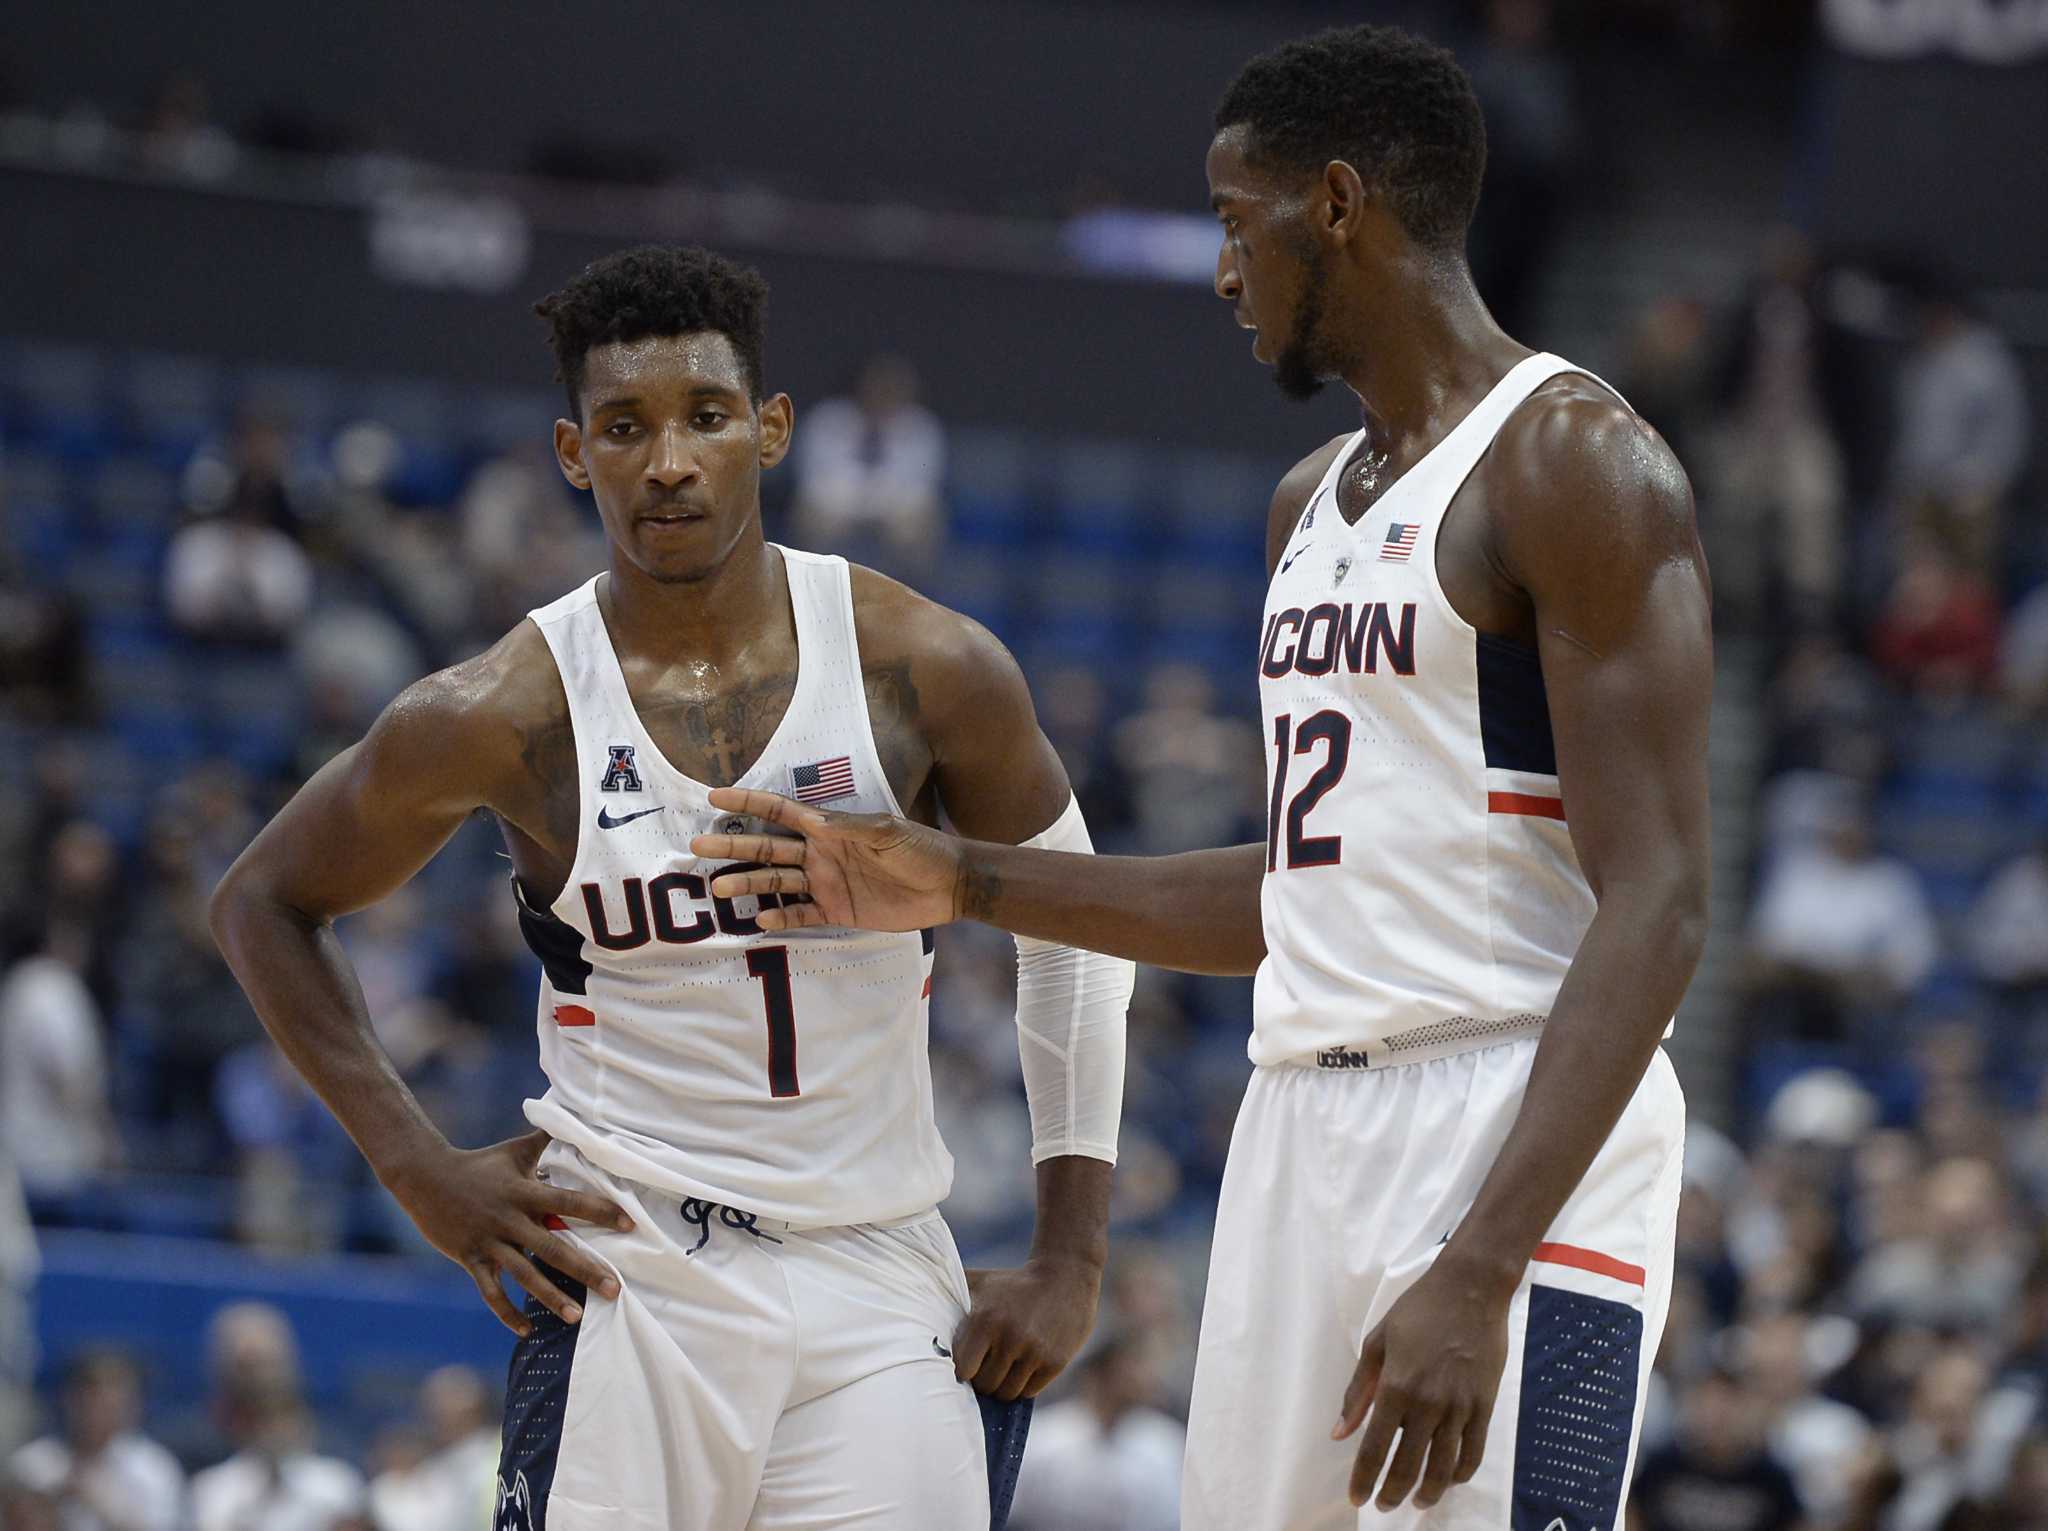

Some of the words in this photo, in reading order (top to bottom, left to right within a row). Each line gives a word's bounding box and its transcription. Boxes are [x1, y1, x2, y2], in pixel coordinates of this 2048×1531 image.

[1267, 709, 1352, 873] 12
[580, 861, 814, 951] UCO
[745, 945, 801, 1098] 1
[1317, 1051, 1368, 1068] UCONN
